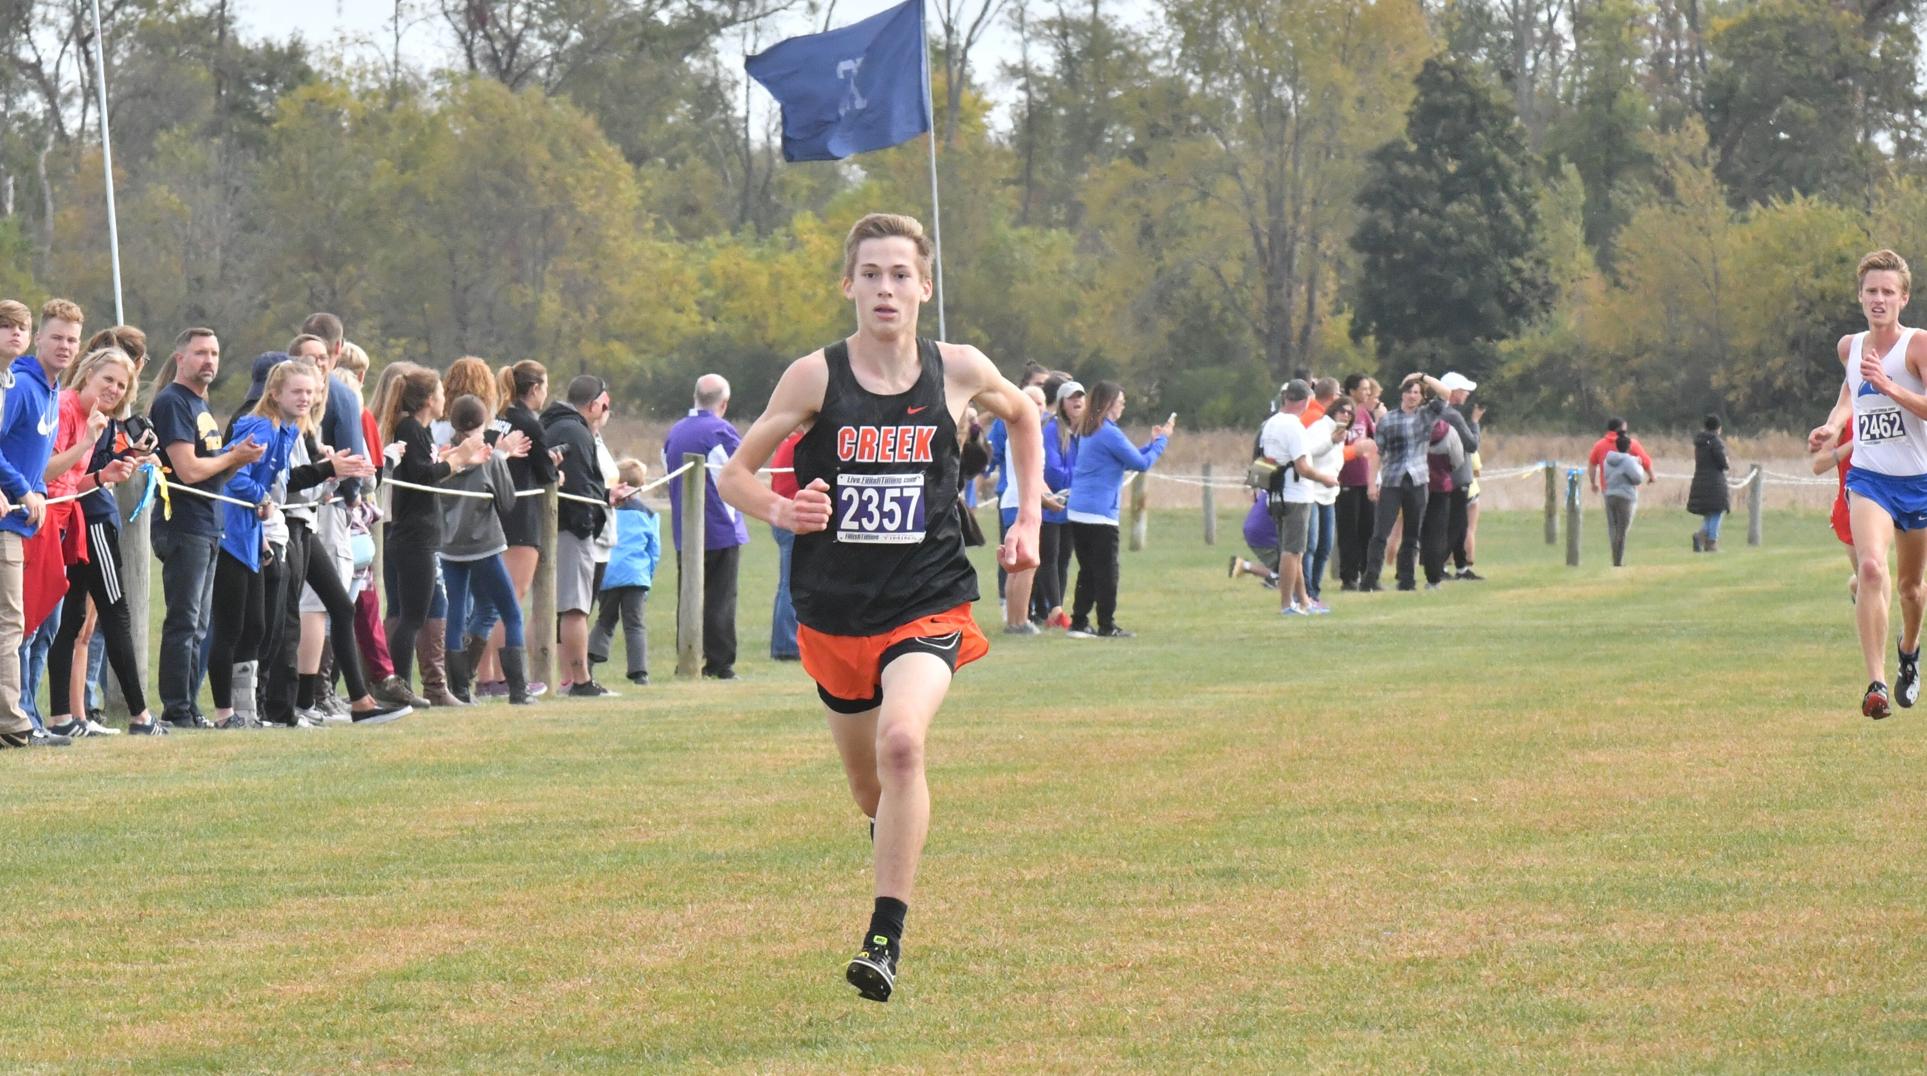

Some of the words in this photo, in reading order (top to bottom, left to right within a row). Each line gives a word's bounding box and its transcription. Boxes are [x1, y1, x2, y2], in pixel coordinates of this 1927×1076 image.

[837, 426, 937, 462] CREEK
[1860, 412, 1904, 440] 2462
[840, 487, 920, 531] 2357
